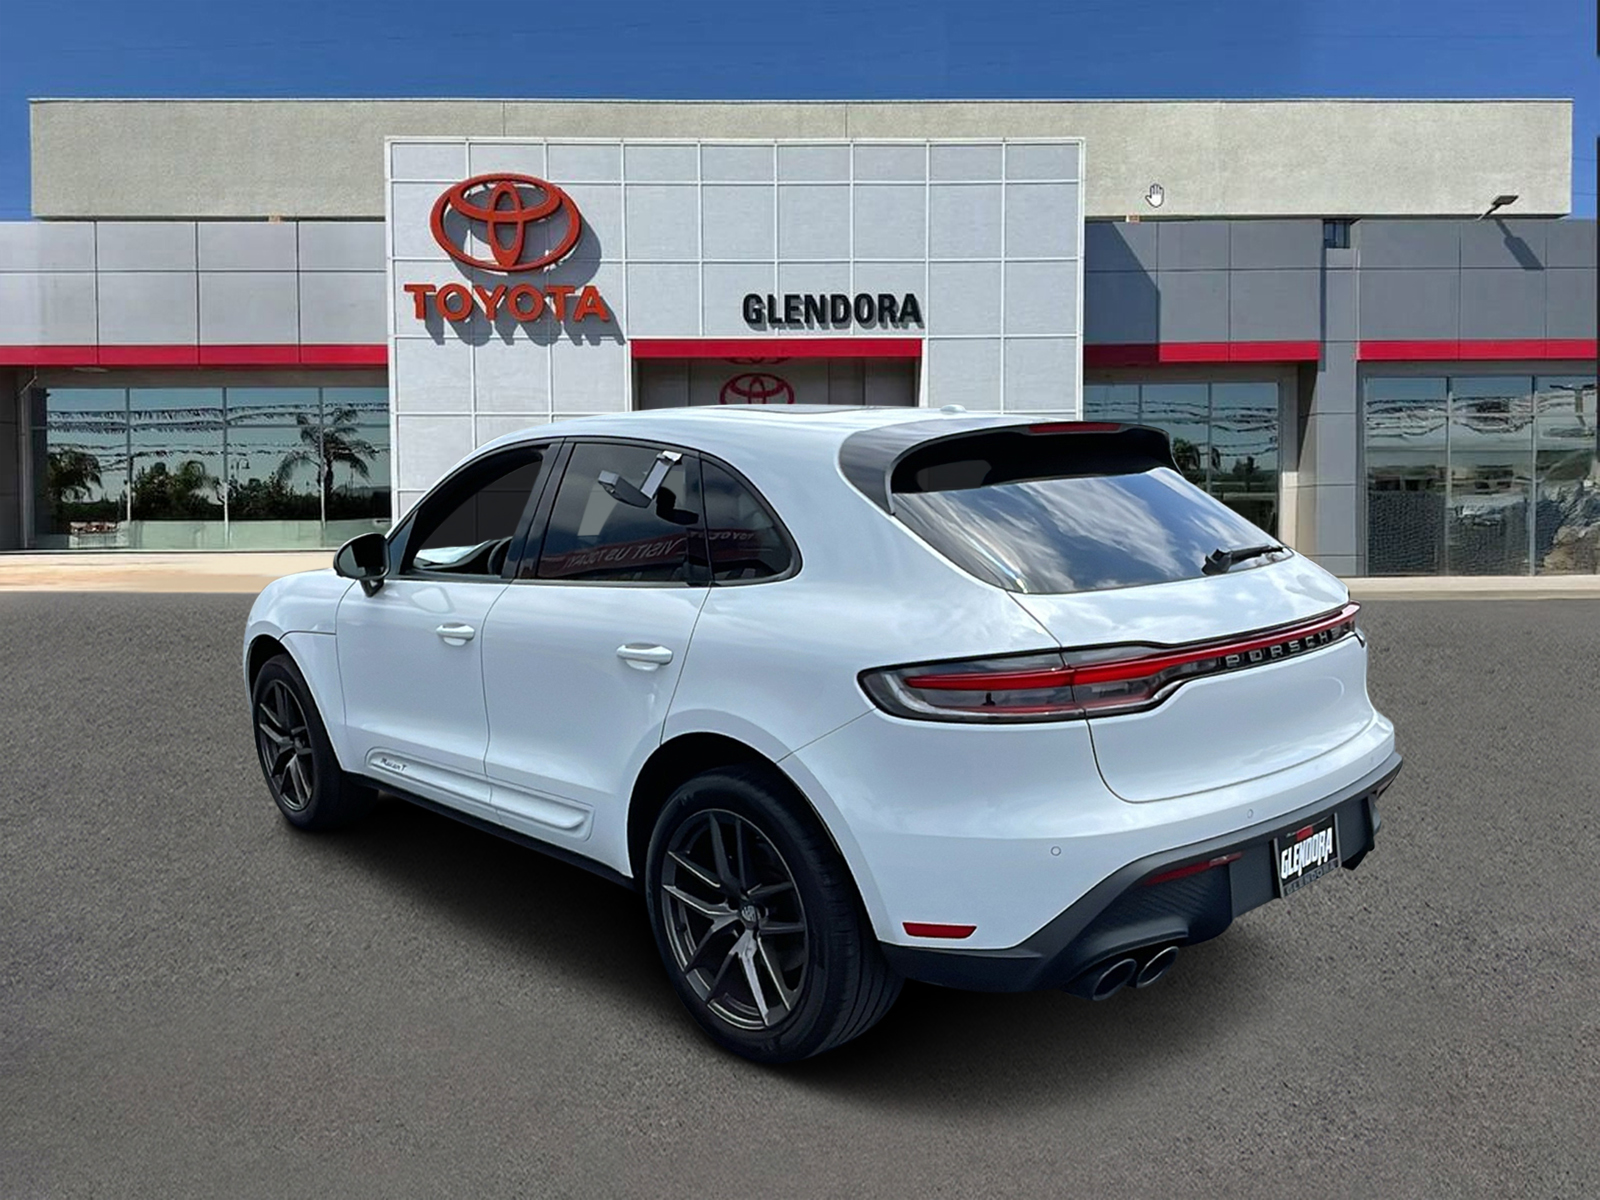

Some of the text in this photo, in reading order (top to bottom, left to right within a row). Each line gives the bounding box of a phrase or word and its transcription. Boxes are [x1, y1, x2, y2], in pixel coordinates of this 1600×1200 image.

[404, 283, 610, 322] TOYOTA
[743, 293, 923, 325] GLENDORA
[1225, 627, 1341, 668] PORSCHE
[1281, 827, 1333, 879] GLENDORA
